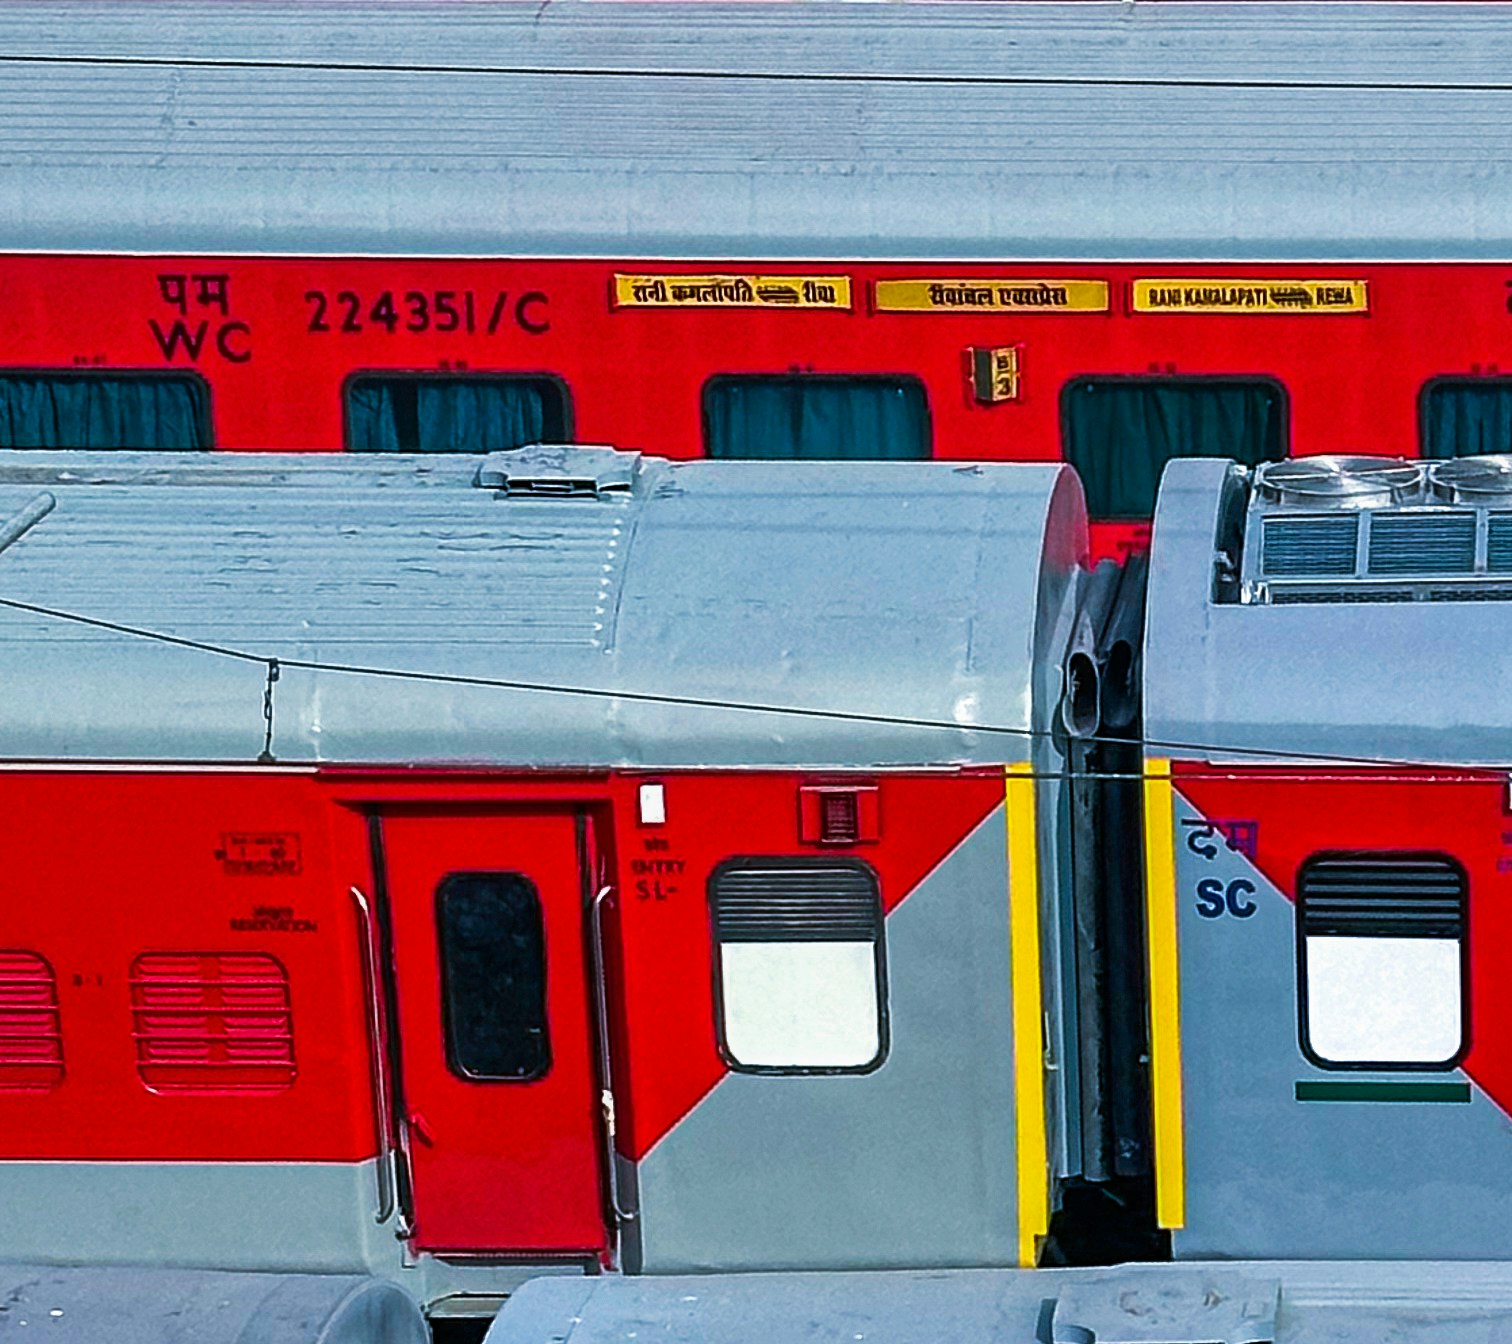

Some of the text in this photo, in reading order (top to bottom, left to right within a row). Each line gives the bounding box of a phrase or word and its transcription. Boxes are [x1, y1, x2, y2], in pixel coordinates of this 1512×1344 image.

[157, 274, 229, 316] पम
[304, 291, 551, 335] 224351/C
[148, 319, 252, 363] WC
[1195, 878, 1258, 919] SC
